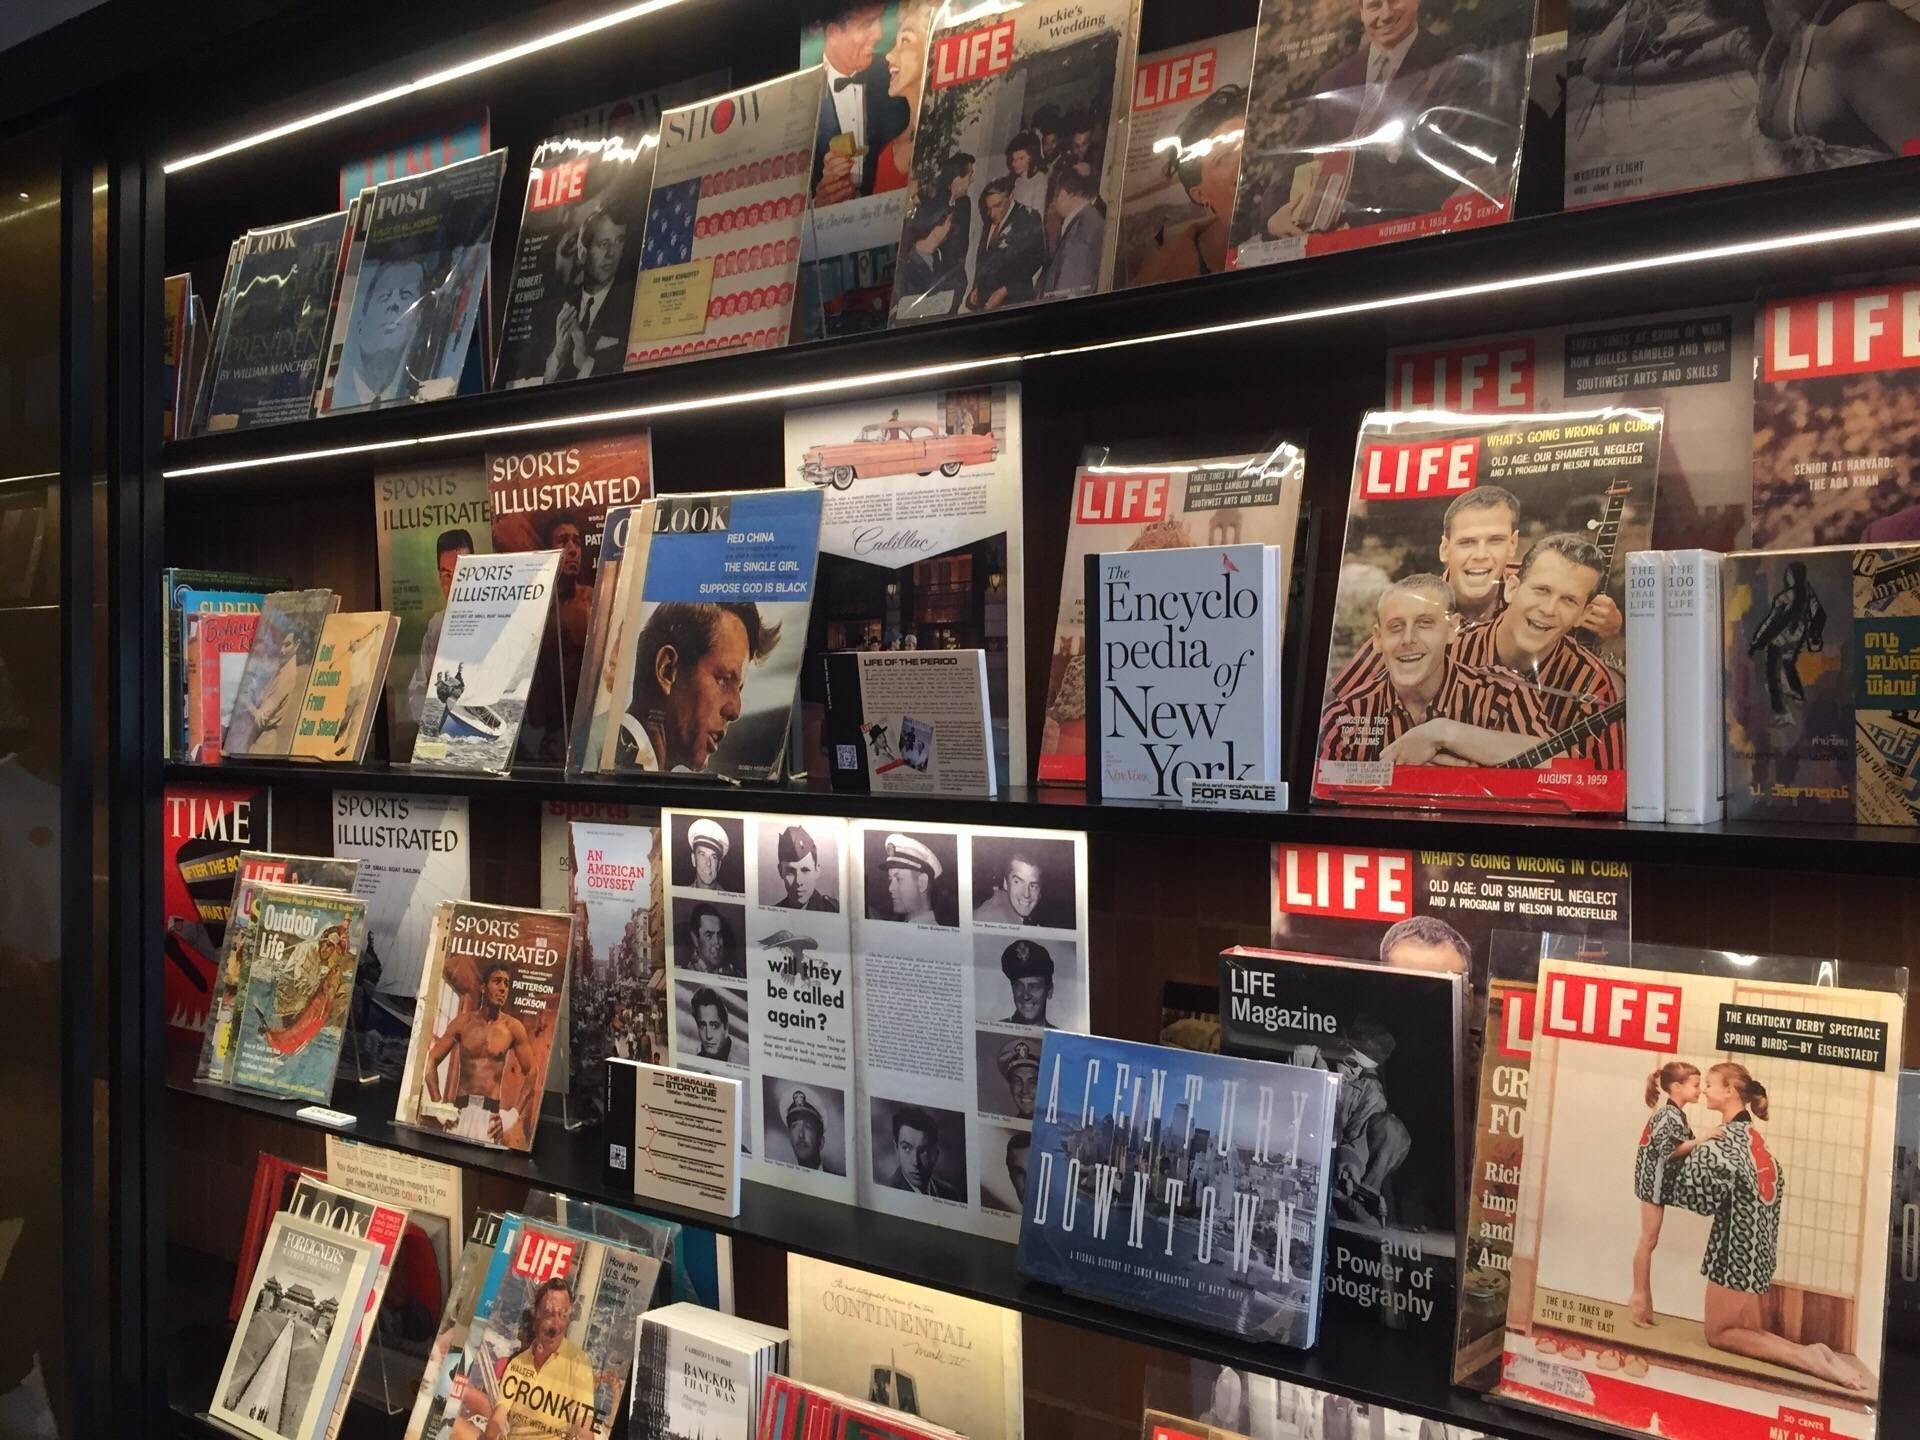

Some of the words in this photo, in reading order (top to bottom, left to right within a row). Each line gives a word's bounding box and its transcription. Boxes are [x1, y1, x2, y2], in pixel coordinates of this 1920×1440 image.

[1037, 3, 1084, 29] Jackie's
[1048, 13, 1106, 40] Wedding
[934, 25, 1013, 83] LIFE
[1134, 52, 1214, 103] LIFE
[1615, 160, 1645, 175] FLIGHT
[532, 159, 589, 208] LIFE
[376, 187, 432, 220] POST
[1453, 201, 1473, 224] 25
[246, 229, 297, 256] LOOK
[1379, 221, 1417, 238] NOVEMBER
[1401, 347, 1529, 411] LIFE
[1576, 374, 1630, 392] SOUTHWEST
[1634, 370, 1657, 385] ARTS
[1662, 368, 1682, 382] AND
[1686, 364, 1719, 380] SKILLS
[1487, 432, 1523, 448] WHAT'S
[1527, 429, 1560, 443] GOING
[1564, 423, 1604, 439] WRONG
[1608, 421, 1620, 435] IN
[1624, 419, 1655, 433] CUBA
[492, 448, 582, 483] SPORTS
[1490, 468, 1505, 479] AND
[1515, 464, 1549, 476] PROGRAM
[1550, 462, 1561, 473] BY
[1563, 460, 1591, 471] NELSON
[1592, 455, 1643, 469] ROCKEFELLER
[1491, 455, 1508, 468] OLD
[1533, 451, 1552, 463] OUR
[1554, 446, 1600, 462] SHAMEFUL
[1603, 442, 1645, 456] NEGLECT
[1794, 461, 1828, 476] SENIOR
[1831, 460, 1843, 473] AT
[1366, 443, 1475, 495] LIFE
[382, 472, 458, 502] SPORTS
[493, 474, 642, 516] ILLUSTRATED
[1809, 479, 1826, 491] THE
[1852, 475, 1879, 488] KHAN
[1081, 478, 1168, 520] LIFE
[1191, 498, 1222, 509] SOUTHWEST
[653, 506, 729, 534] LOOK
[727, 533, 744, 544] RED
[746, 532, 775, 543] CHINA
[852, 525, 940, 556] Cadillac
[456, 564, 514, 582] SPORTS
[724, 562, 741, 573] THE
[742, 561, 776, 572] SINGLE
[778, 560, 800, 572] GIRL
[1107, 566, 1130, 580] The
[1631, 566, 1656, 576] THE
[451, 583, 545, 603] ILLUSTRATED
[699, 583, 740, 594] SUPPOSE
[742, 582, 763, 594] GOD
[764, 582, 774, 593] IS
[775, 582, 808, 593] BLACK
[1630, 576, 1656, 589] 100
[1668, 576, 1695, 588] 100
[1104, 572, 1259, 632] Encyclo
[1630, 599, 1656, 609] LIFE
[1668, 598, 1695, 610] LIFE
[920, 657, 958, 665] PERIOD
[1105, 624, 1213, 682] pedia
[1213, 649, 1255, 699] of
[312, 668, 342, 687] Lessons
[305, 692, 326, 711] From
[1105, 685, 1227, 740] New
[299, 717, 316, 736] Sam
[1357, 726, 1384, 736] SELLERS
[1139, 740, 1256, 797] York
[1536, 773, 1573, 785] AUGUST
[1587, 774, 1608, 785] 1959
[337, 794, 409, 820] SPORTS
[1191, 788, 1227, 799] FOR
[1229, 789, 1276, 801] SALE
[166, 797, 251, 844] TIME
[337, 824, 459, 853] ILLUSTRATED
[586, 849, 604, 861] AN
[1420, 850, 1465, 867] WHAT'S
[1470, 854, 1511, 870] GOING
[1516, 856, 1565, 874] WRONG
[1571, 859, 1585, 875] IN
[1590, 860, 1629, 879] CUBA
[586, 863, 646, 879] AMERICAN
[586, 875, 636, 891] ODYSSEY
[1285, 849, 1406, 915] LIFE
[1429, 879, 1449, 893] OLD
[1453, 881, 1477, 896] AGE:
[1480, 883, 1503, 897] OUR
[1507, 884, 1564, 902] SHAMEFUL
[1568, 889, 1618, 906] NEGLECT
[1429, 895, 1447, 907] AND
[1449, 897, 1456, 908] A
[1459, 898, 1500, 911] PROGRAM
[1504, 901, 1515, 913] BY
[1519, 901, 1553, 916] NELSON
[1556, 904, 1618, 921] ROCKEFELLER
[263, 904, 319, 939] Outdoor
[454, 915, 520, 940] SPORTS
[259, 932, 285, 961] Life
[450, 936, 559, 967] ILLUSTRATED
[767, 956, 798, 977] will
[801, 959, 843, 986] they
[1231, 967, 1277, 998] LIFE
[512, 980, 554, 994] PATTERSON
[767, 978, 789, 1000] be
[793, 985, 845, 1010] called
[513, 996, 547, 1010] JACKSON
[1231, 995, 1338, 1035] Magazine
[1550, 980, 1675, 1046] LIFE
[767, 1008, 828, 1032] again?
[1726, 1011, 1742, 1024] THE
[1745, 1013, 1793, 1030] KENTUCKY
[1795, 1019, 1826, 1034] DERBY
[1828, 1022, 1881, 1041] SPECTACLE
[1723, 1032, 1757, 1048] SPRING
[1817, 1043, 1880, 1063] EISENSTAEDT
[665, 1080, 718, 1098] STORYLINE
[666, 1074, 681, 1083] THE
[680, 1076, 718, 1090] PARALLEL
[1081, 1058, 1309, 1170] CENTURY
[293, 1193, 370, 1240] LOOK
[1033, 1151, 1297, 1284] DOWNTOWN
[284, 1231, 346, 1265] FOREIGNERS
[516, 1235, 573, 1281] LIFE
[1380, 1237, 1424, 1263] and
[608, 1256, 626, 1270] How
[626, 1261, 639, 1274] the
[1076, 1251, 1096, 1265] VISUAL
[1097, 1257, 1122, 1273] HISTORY
[1336, 1246, 1404, 1281] Power
[1409, 1266, 1434, 1291] of
[620, 1270, 641, 1289] Army
[1545, 1295, 1559, 1306] THE
[1578, 1302, 1601, 1317] TAKES
[1604, 1309, 1614, 1320] UP
[1541, 1308, 1563, 1322] STYLE
[1566, 1314, 1577, 1324] OF
[1580, 1316, 1593, 1330] THE
[1597, 1321, 1616, 1334] EAST
[509, 1362, 535, 1379] WALTER
[684, 1361, 736, 1394] BANGKOK
[1797, 1417, 1825, 1431] CENTS
